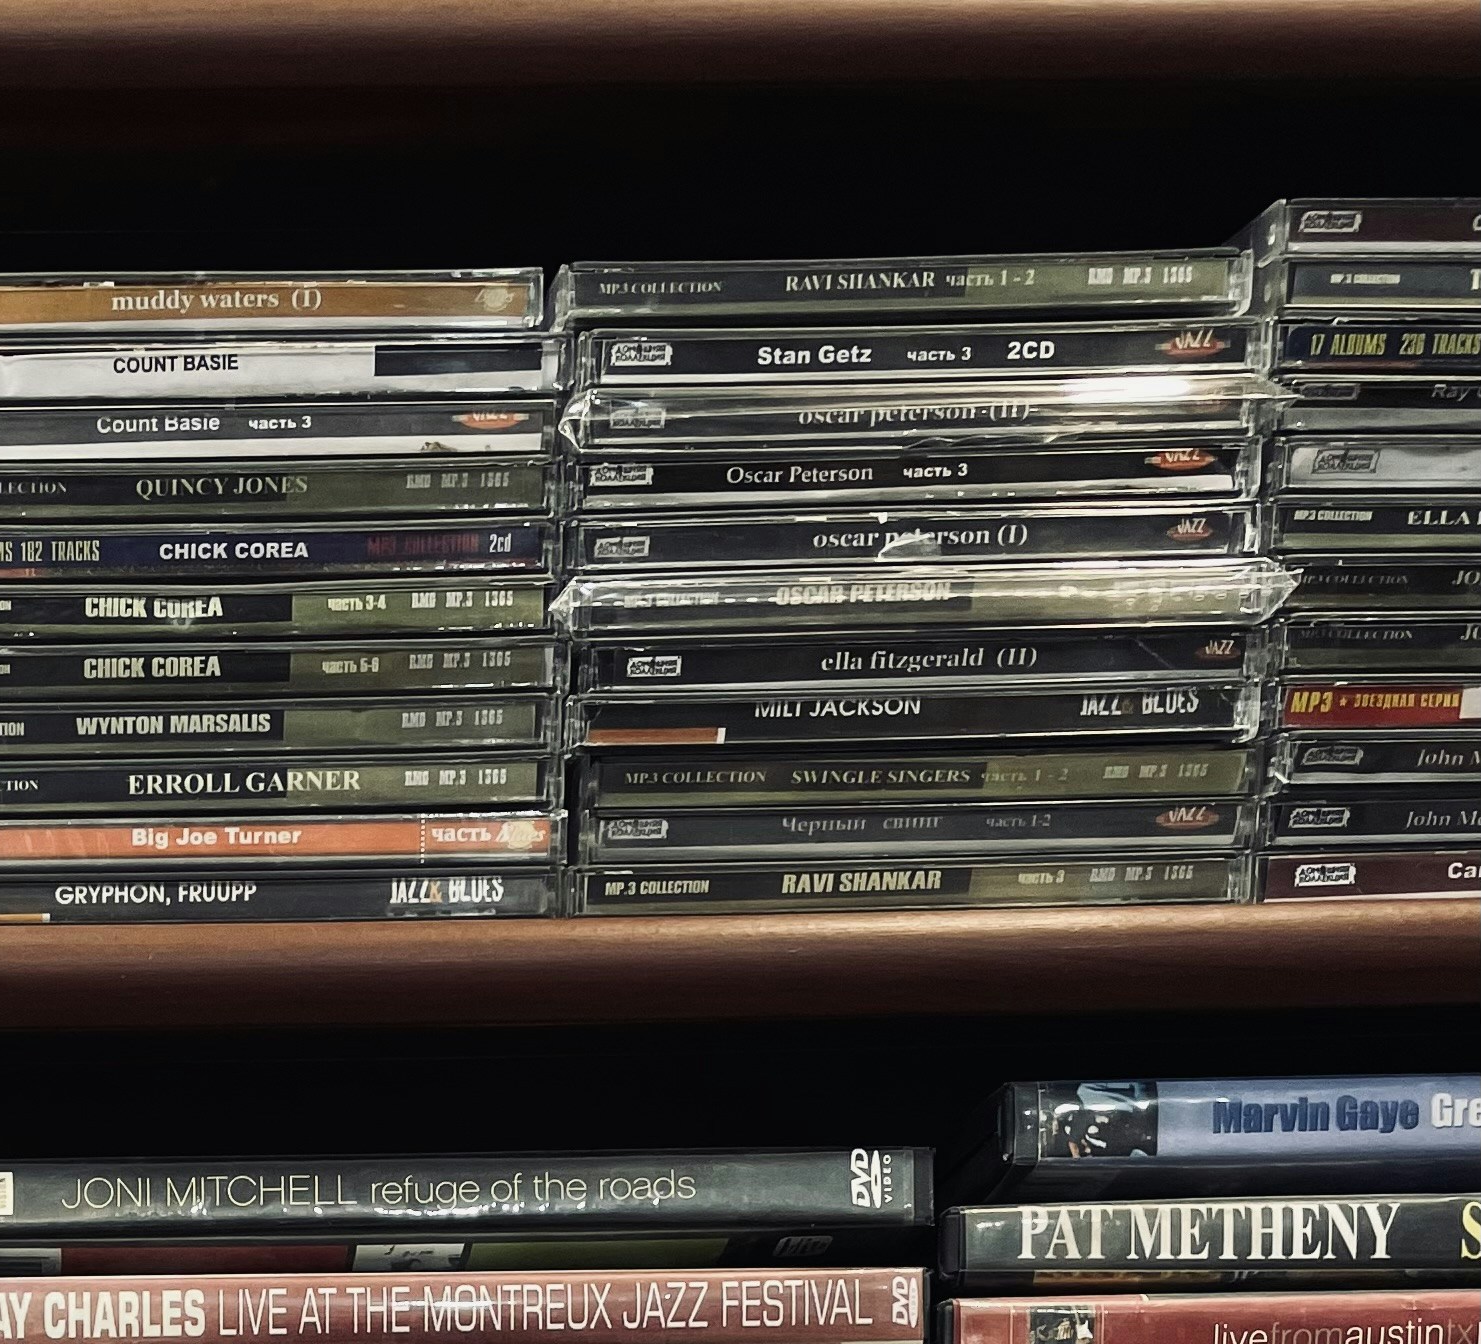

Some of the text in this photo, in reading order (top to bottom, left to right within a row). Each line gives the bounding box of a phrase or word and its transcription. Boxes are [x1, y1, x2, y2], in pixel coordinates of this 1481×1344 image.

[111, 288, 322, 314] muddy waters (I)
[758, 345, 872, 364] Stan Getz
[907, 347, 971, 362] часть 3
[1007, 341, 1054, 360] 2CD
[113, 353, 238, 374] COUNT BASIE
[131, 827, 301, 848] Big Joe Turner
[1018, 1203, 1400, 1260] PAT METHENY
[43, 1288, 206, 1338] CHARLES
[219, 1289, 288, 1335] LIVE
[299, 1287, 336, 1333] AT
[346, 1287, 410, 1333] THE
[424, 1283, 612, 1332] MONTREUX
[622, 1281, 708, 1330] JAZZ
[722, 1278, 873, 1327] FESTIVAL
